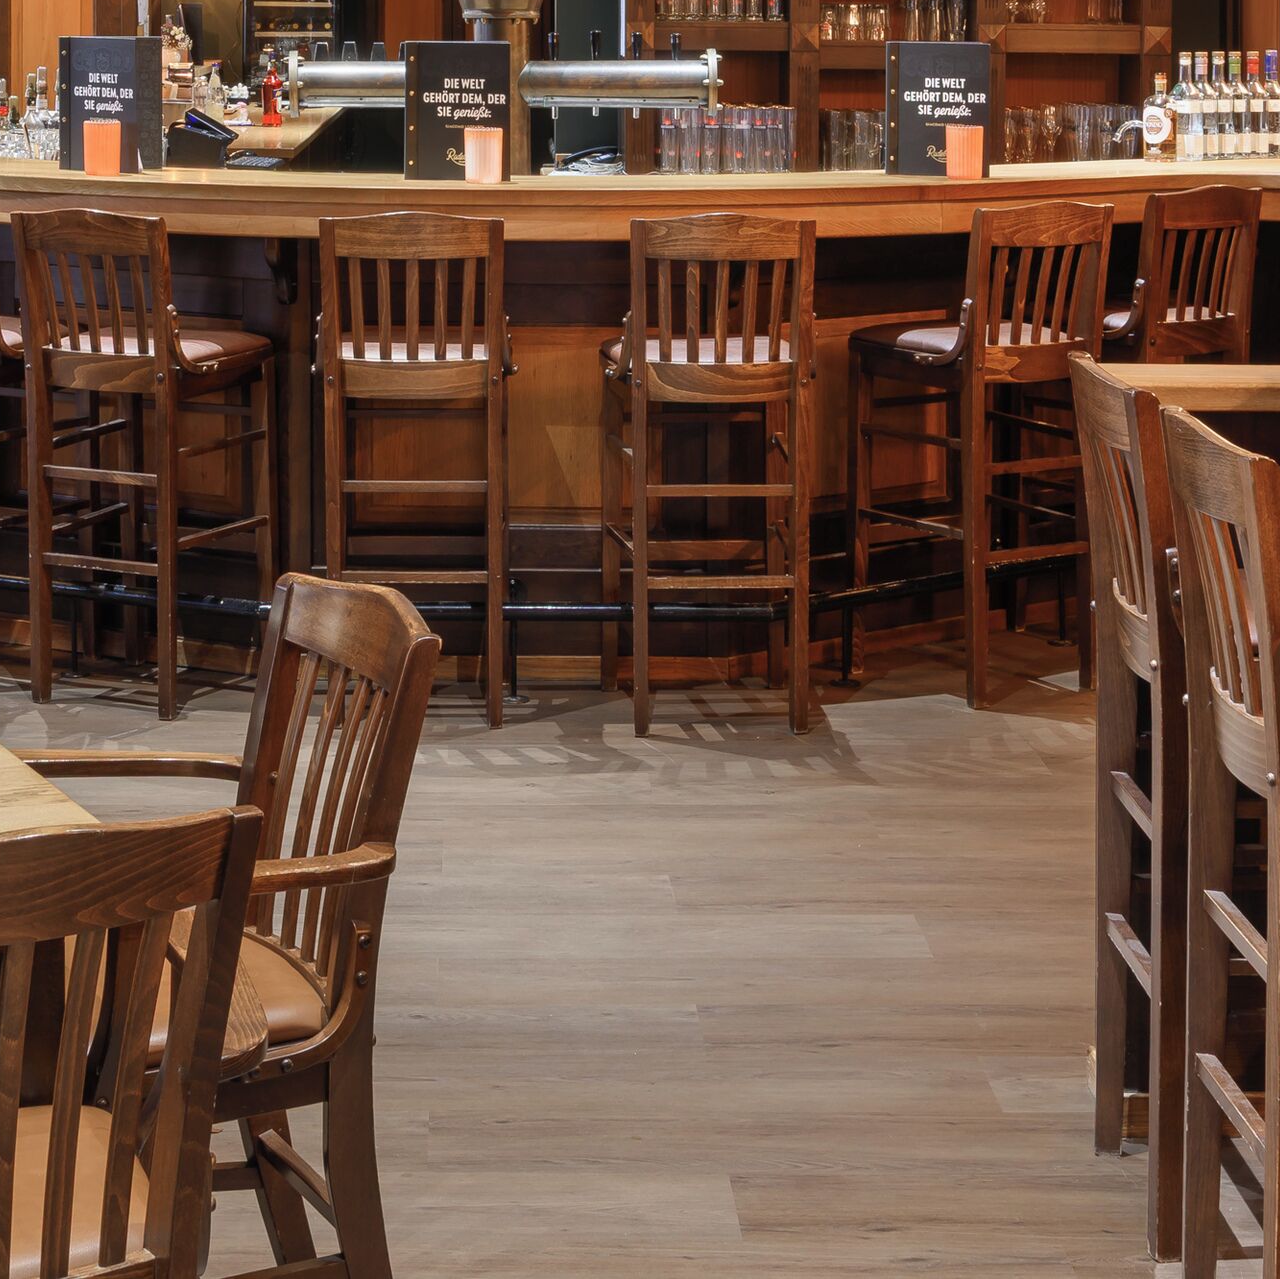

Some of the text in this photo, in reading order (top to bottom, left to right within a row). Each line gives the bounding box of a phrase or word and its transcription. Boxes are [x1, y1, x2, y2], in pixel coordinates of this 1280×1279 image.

[88, 72, 118, 84] DIE WELT
[444, 78, 486, 90] DIE WELT
[925, 78, 966, 89] DIE WELT
[74, 84, 101, 97] GEHÖRT
[120, 88, 133, 99] DER
[423, 90, 460, 103] GEHÖRT
[487, 93, 506, 105] DER
[904, 89, 941, 102] GEHÖRT
[967, 92, 986, 104] DER
[84, 100, 95, 110] SIE
[918, 105, 932, 116] SIE
[437, 106, 452, 117] SIE
